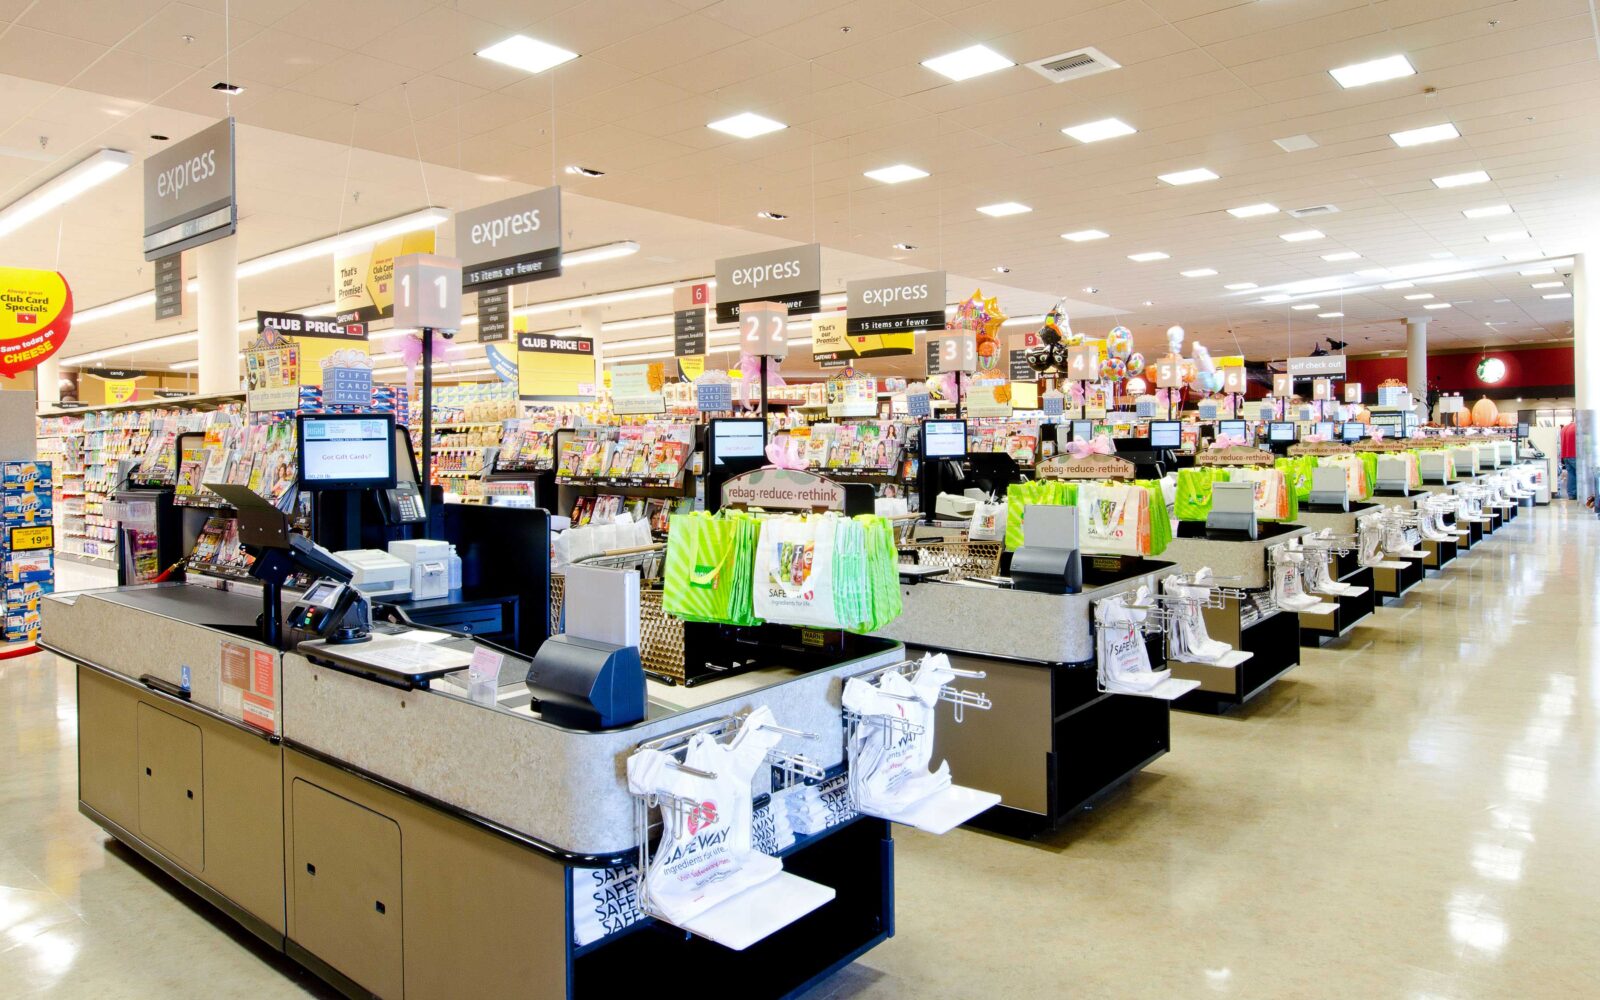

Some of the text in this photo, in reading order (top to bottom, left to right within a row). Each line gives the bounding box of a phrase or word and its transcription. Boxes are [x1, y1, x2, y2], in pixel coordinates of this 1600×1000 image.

[157, 149, 216, 199] express
[471, 208, 541, 247] express
[341, 267, 358, 278] That's
[373, 265, 383, 275] Club
[469, 260, 543, 283] 15 items or fewer
[732, 258, 801, 289] express
[338, 285, 363, 298] Promise!
[343, 280, 353, 288] our
[401, 274, 447, 308] 1 1
[0, 294, 49, 305] Club Card
[695, 288, 702, 300] 6
[862, 282, 928, 306] express
[5, 303, 48, 313] Specials
[731, 306, 740, 316] 15
[264, 317, 345, 334] CLUB PRICE
[746, 316, 783, 341] 2 2
[861, 318, 929, 330] 15 items or fewer
[0, 329, 55, 353] Save today on
[522, 337, 578, 350] CLUB PRICE
[816, 336, 842, 345] Promise!
[1027, 335, 1034, 344] 9
[3, 340, 54, 364] CHEESE
[945, 340, 957, 361] 3
[966, 340, 974, 360] 3
[1073, 354, 1084, 372] 4
[1291, 361, 1304, 370] self
[1305, 360, 1325, 369] check
[1161, 365, 1171, 380] 5
[1228, 374, 1237, 386] 6
[338, 382, 369, 390] CARD
[1278, 379, 1286, 390] 7
[1316, 383, 1325, 394] 8
[1348, 387, 1356, 397] 9
[1041, 464, 1129, 475] rebag reduce rethink
[728, 487, 837, 502] rebag reduce rethink
[817, 773, 849, 792] SAFEW
[820, 785, 848, 807] SAFE
[664, 855, 703, 876] ingredients
[592, 864, 640, 887] SAFE
[593, 874, 640, 908] SAFE
[595, 893, 637, 922] SAFE
[602, 908, 640, 934] SAFE
